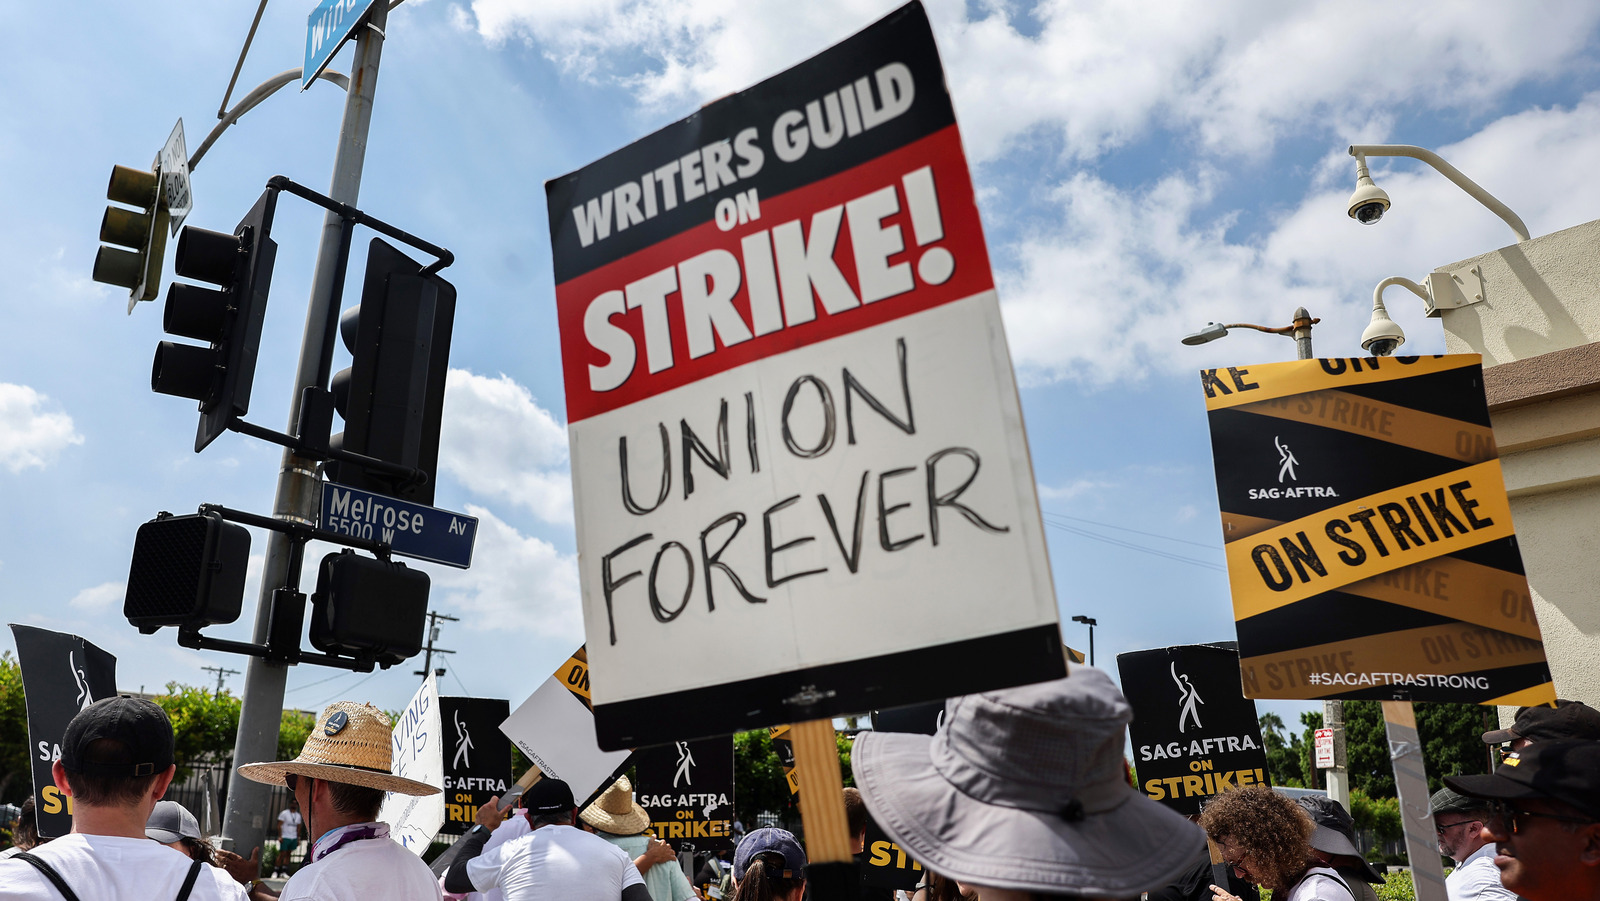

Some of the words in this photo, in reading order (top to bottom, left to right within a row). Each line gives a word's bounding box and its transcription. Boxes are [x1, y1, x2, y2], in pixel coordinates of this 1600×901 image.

[571, 127, 765, 248] WRITERS
[771, 62, 916, 163] GUILD
[714, 188, 761, 232] ON
[583, 165, 955, 392] STRIKE!
[618, 337, 916, 515] UNION
[328, 516, 373, 540] 5500
[382, 527, 395, 545] W
[330, 488, 424, 534] Melrose
[448, 516, 467, 536] Av
[602, 447, 1010, 646] FOREVER
[1250, 530, 1329, 592] ON
[1324, 480, 1494, 567] STRIKE
[1308, 671, 1490, 690] #SAGAFTRASTRONG
[1145, 768, 1266, 801] STRIKE!
[1189, 759, 1214, 773] ON
[455, 793, 473, 803] ON
[675, 810, 695, 820] ON
